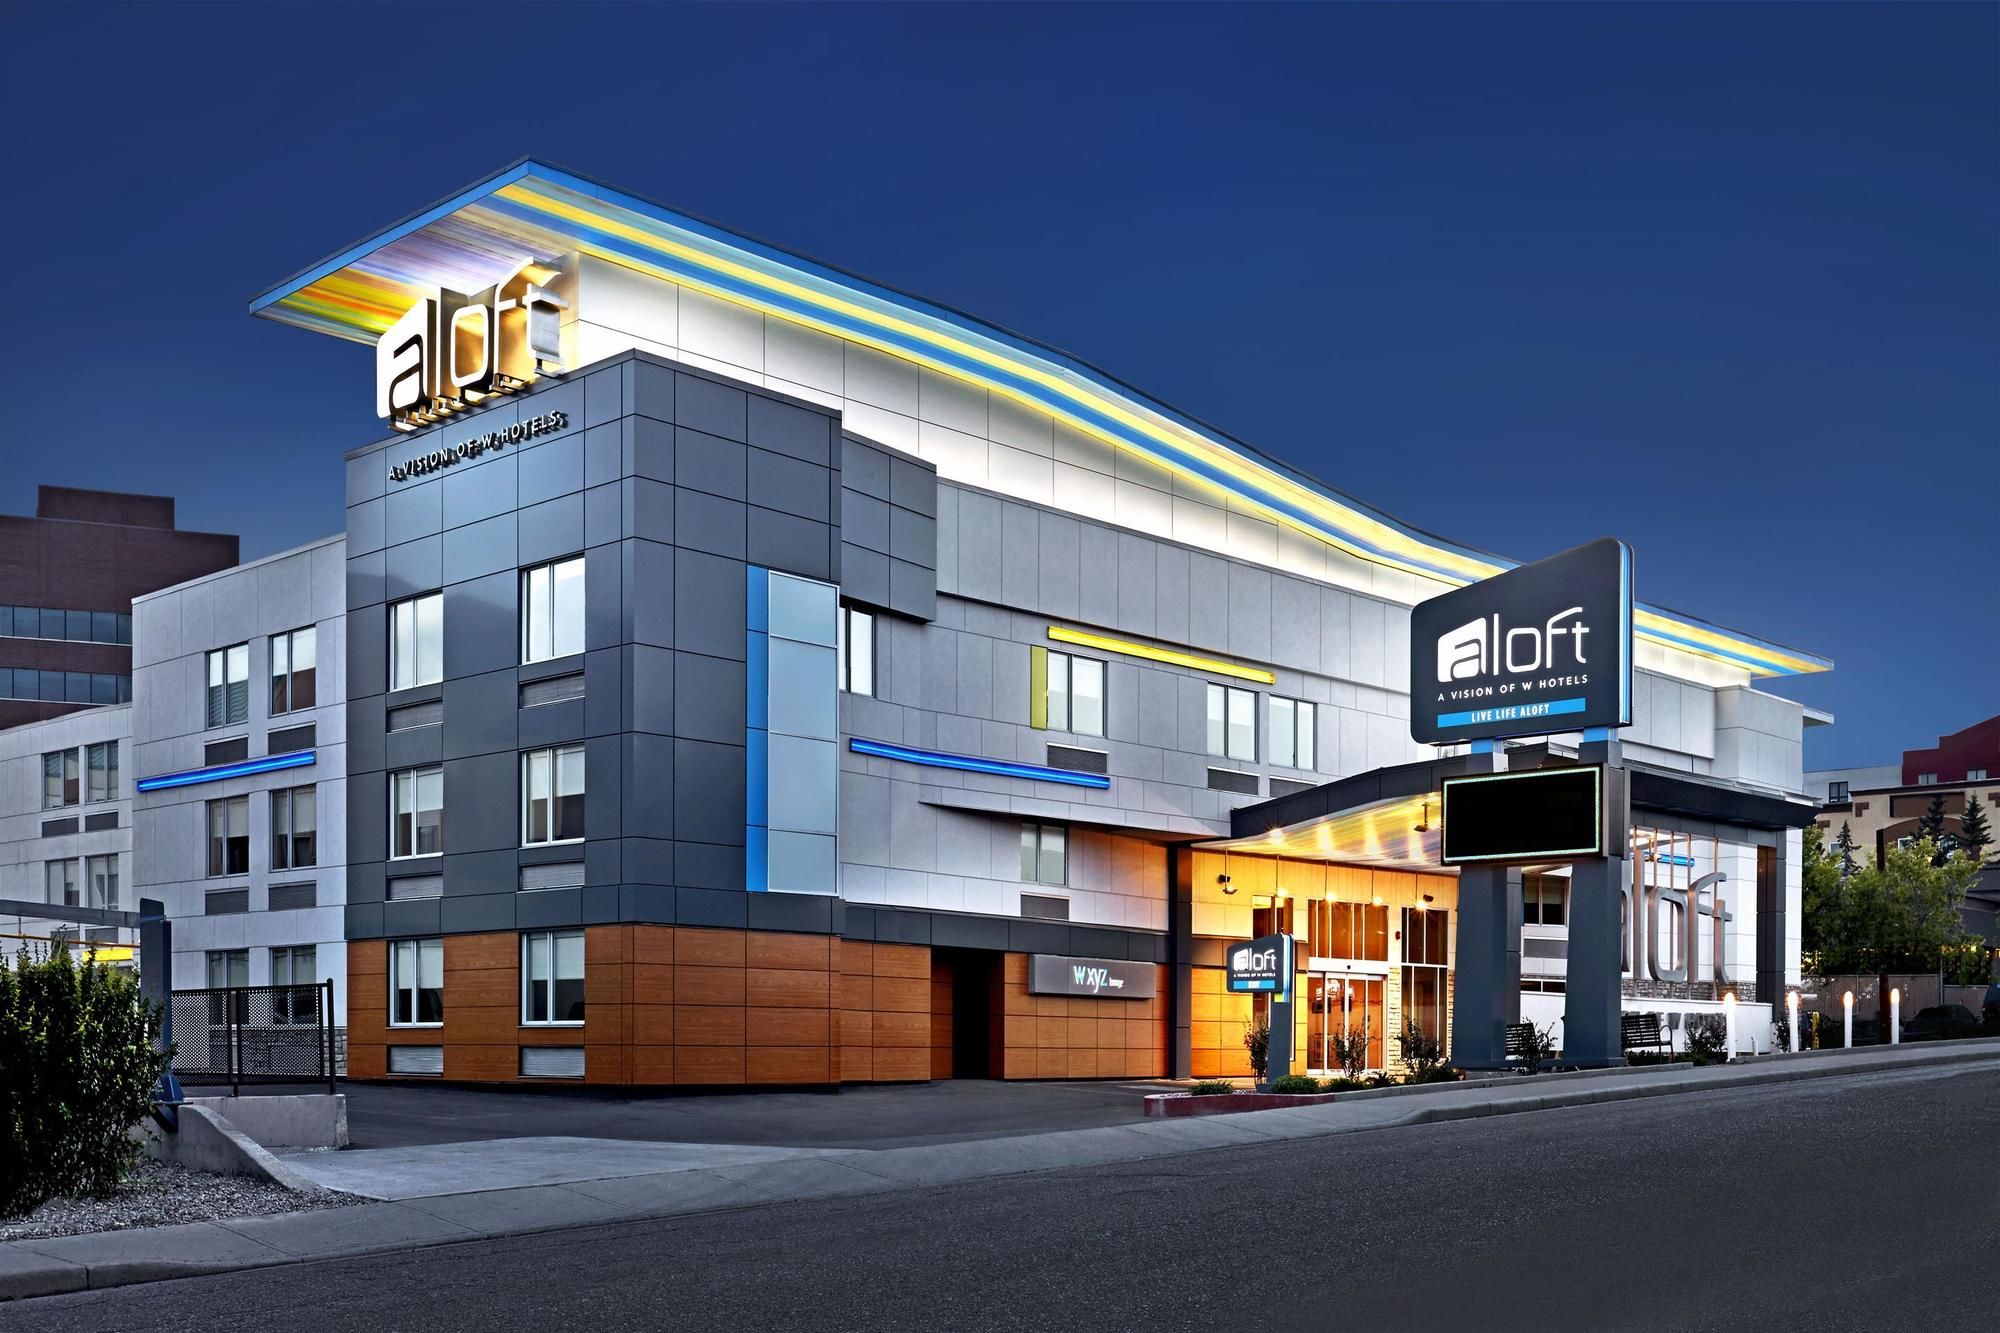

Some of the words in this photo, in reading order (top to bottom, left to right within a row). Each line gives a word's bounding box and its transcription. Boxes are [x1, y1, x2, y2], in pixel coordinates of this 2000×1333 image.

[376, 256, 568, 419] aloft
[403, 450, 448, 475] VISION
[456, 440, 476, 457] OF
[501, 410, 560, 441] HOTELS
[1437, 606, 1590, 683] aloft
[1437, 693, 1445, 702] A
[1451, 686, 1493, 700] VISION
[1500, 683, 1516, 694] OF
[1522, 681, 1533, 691] W
[1539, 674, 1588, 689] HOTELS
[1471, 711, 1492, 723] LIVE
[1495, 708, 1516, 720] LIFE
[1520, 704, 1550, 718] ALOFT
[1621, 848, 1733, 985] loft
[1233, 947, 1276, 971] aloft
